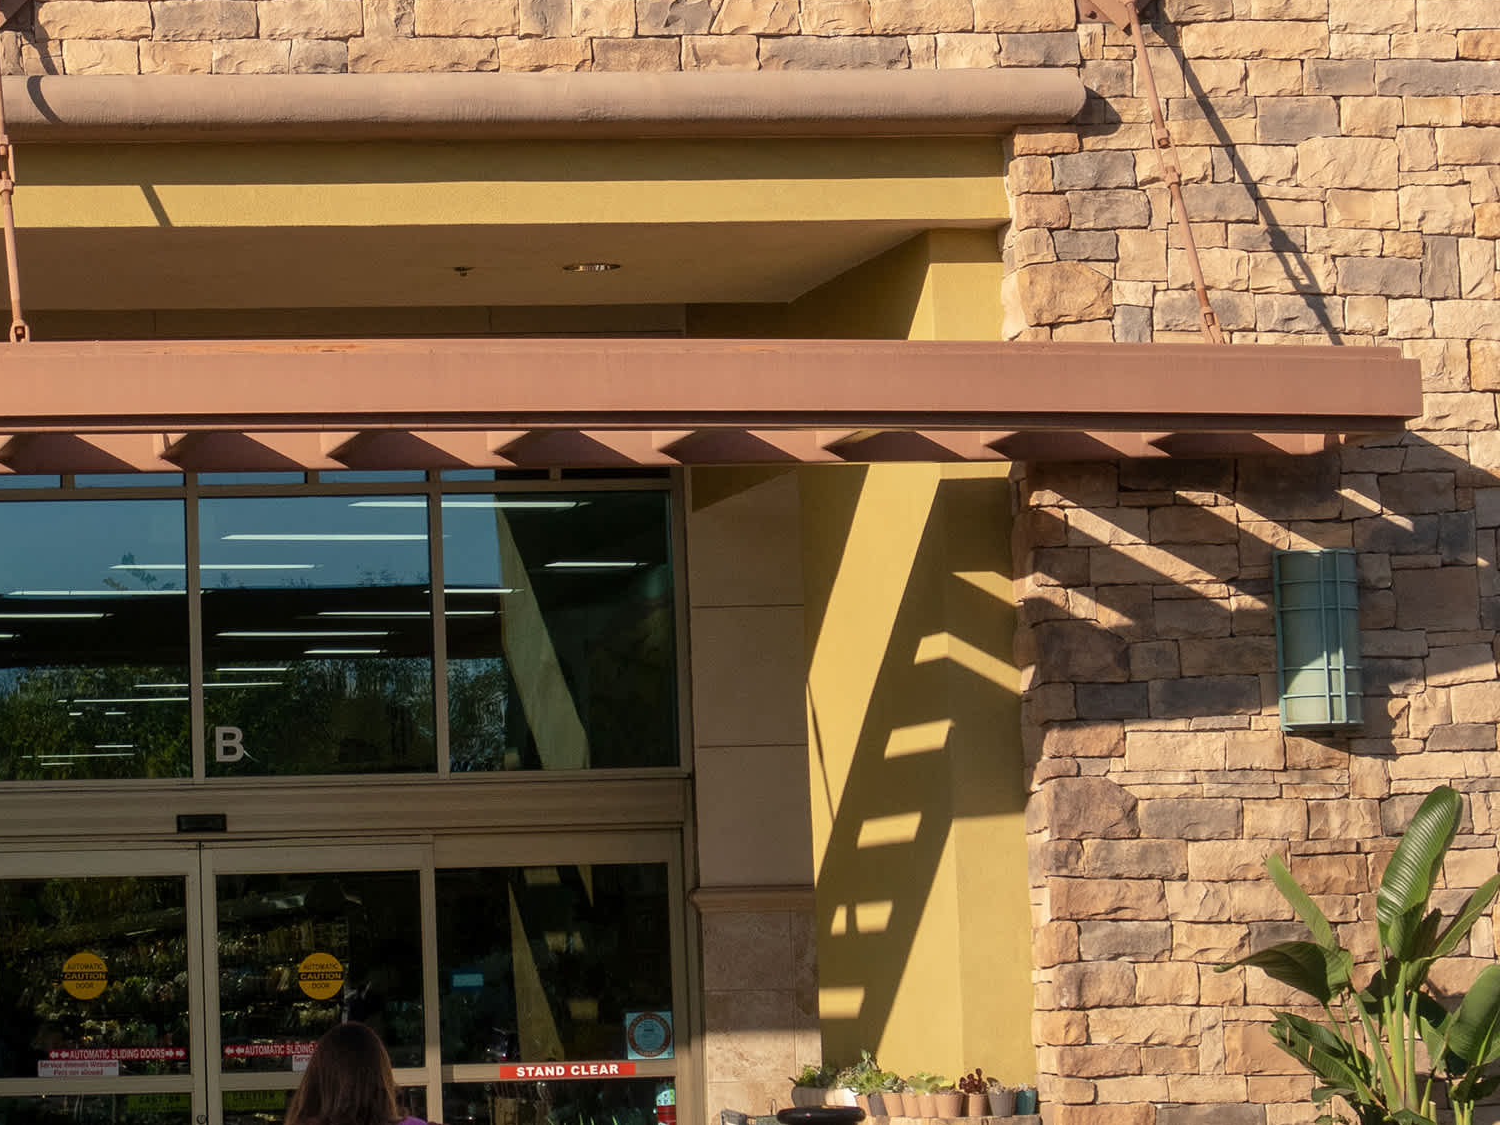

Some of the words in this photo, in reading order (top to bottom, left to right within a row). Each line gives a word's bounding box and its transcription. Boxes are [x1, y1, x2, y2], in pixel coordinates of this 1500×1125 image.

[214, 726, 244, 763] B
[67, 963, 103, 971] AUTOMATIC
[303, 962, 339, 970] AUTOMATIC
[64, 972, 106, 980] CAUTION
[300, 972, 342, 980] CAUTION
[69, 1050, 110, 1060] AUTOMATIC
[111, 1049, 139, 1059] SLIDING
[140, 1048, 165, 1059] DOORS
[244, 1045, 285, 1056] AUTOMATIC
[286, 1043, 314, 1055] SLIDING
[516, 1066, 565, 1077] STAND
[570, 1064, 619, 1076] CLEAR
